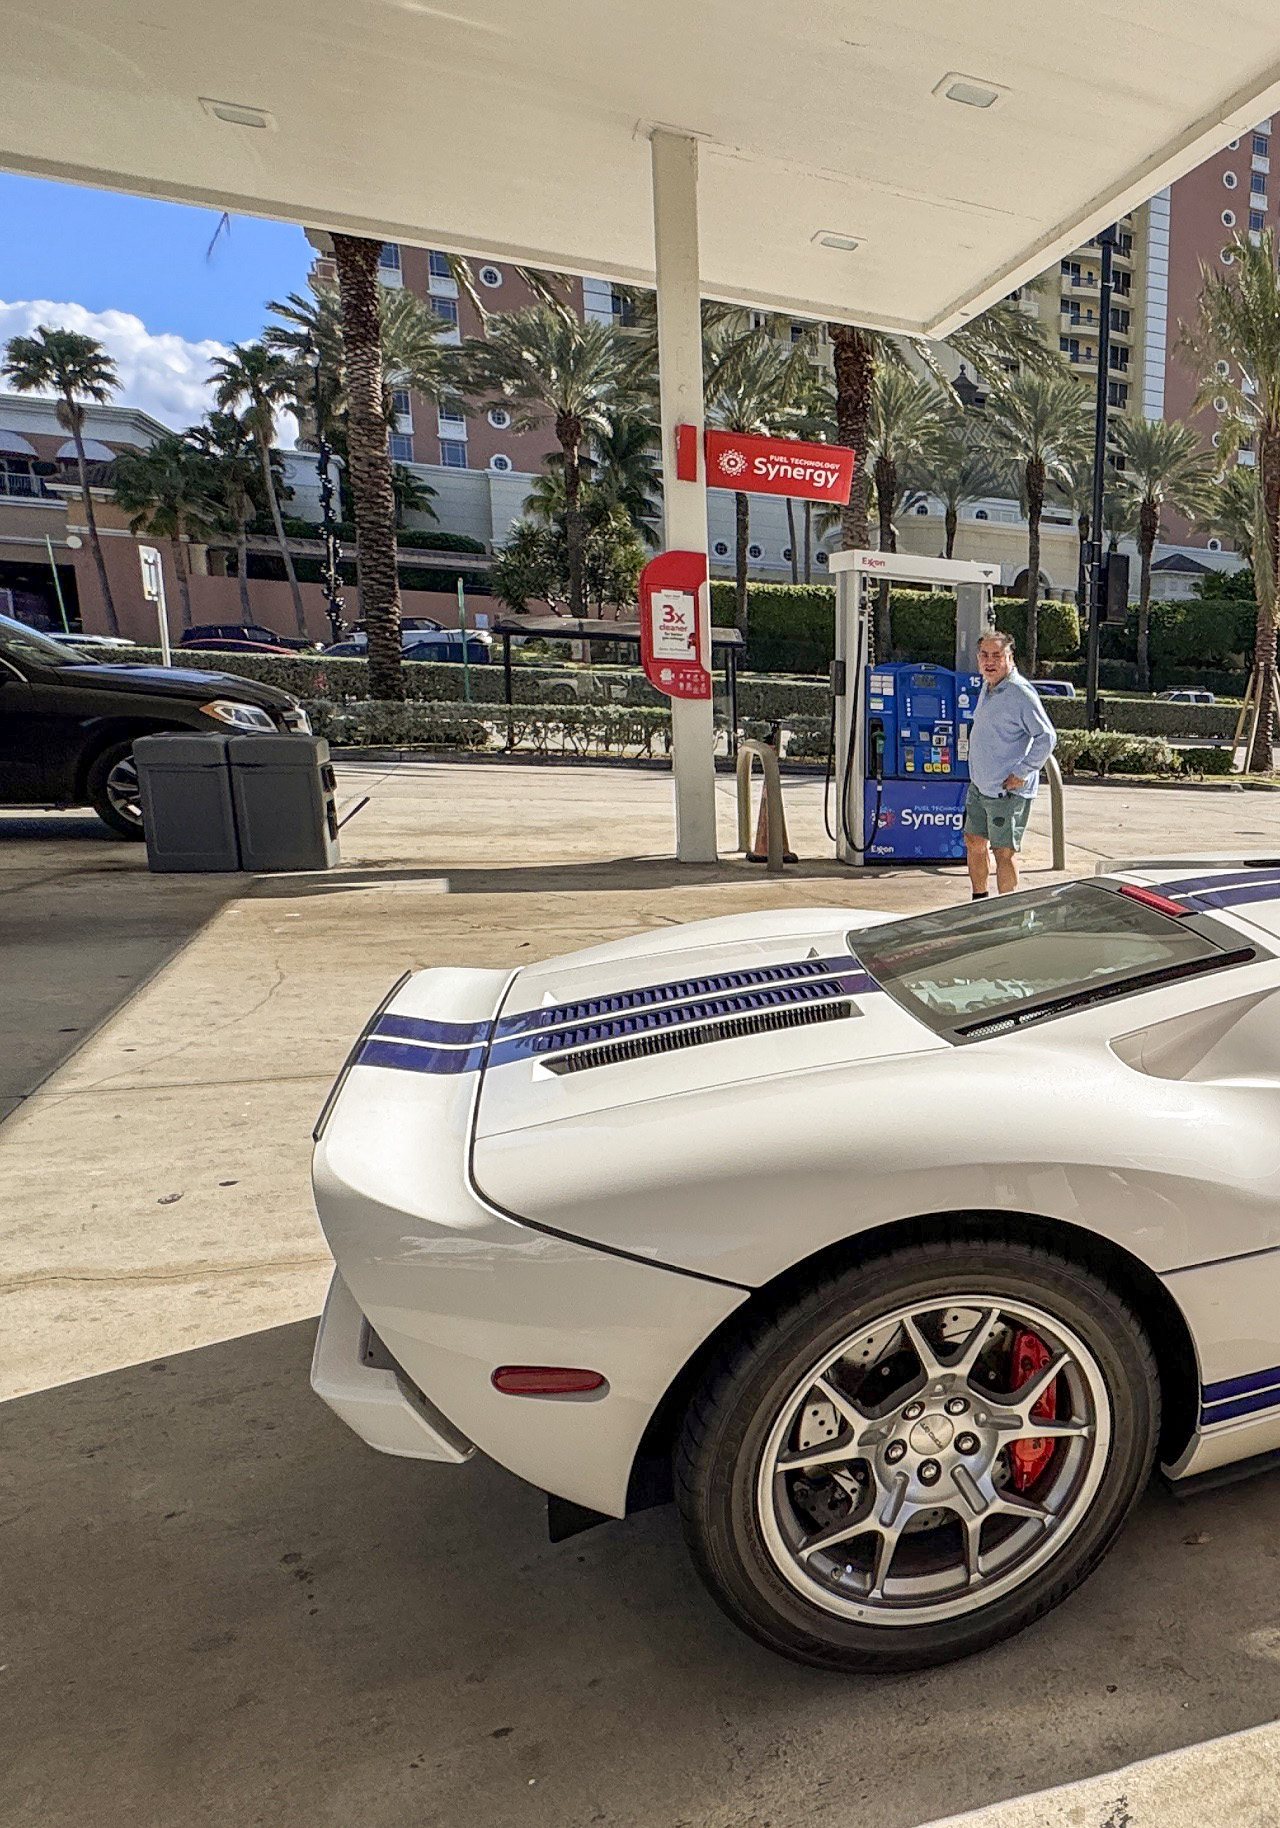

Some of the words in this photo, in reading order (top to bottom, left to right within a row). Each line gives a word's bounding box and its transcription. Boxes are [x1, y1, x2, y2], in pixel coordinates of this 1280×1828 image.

[769, 454, 788, 464] FUEL
[790, 457, 841, 470] TECHNOLOGY
[753, 457, 839, 489] Synergy
[862, 557, 885, 568] Exxon
[662, 604, 685, 624] 3x
[659, 624, 688, 632] cleaner
[969, 676, 981, 687] 15
[901, 808, 964, 831] Synerg
[870, 845, 894, 855] Exxon
